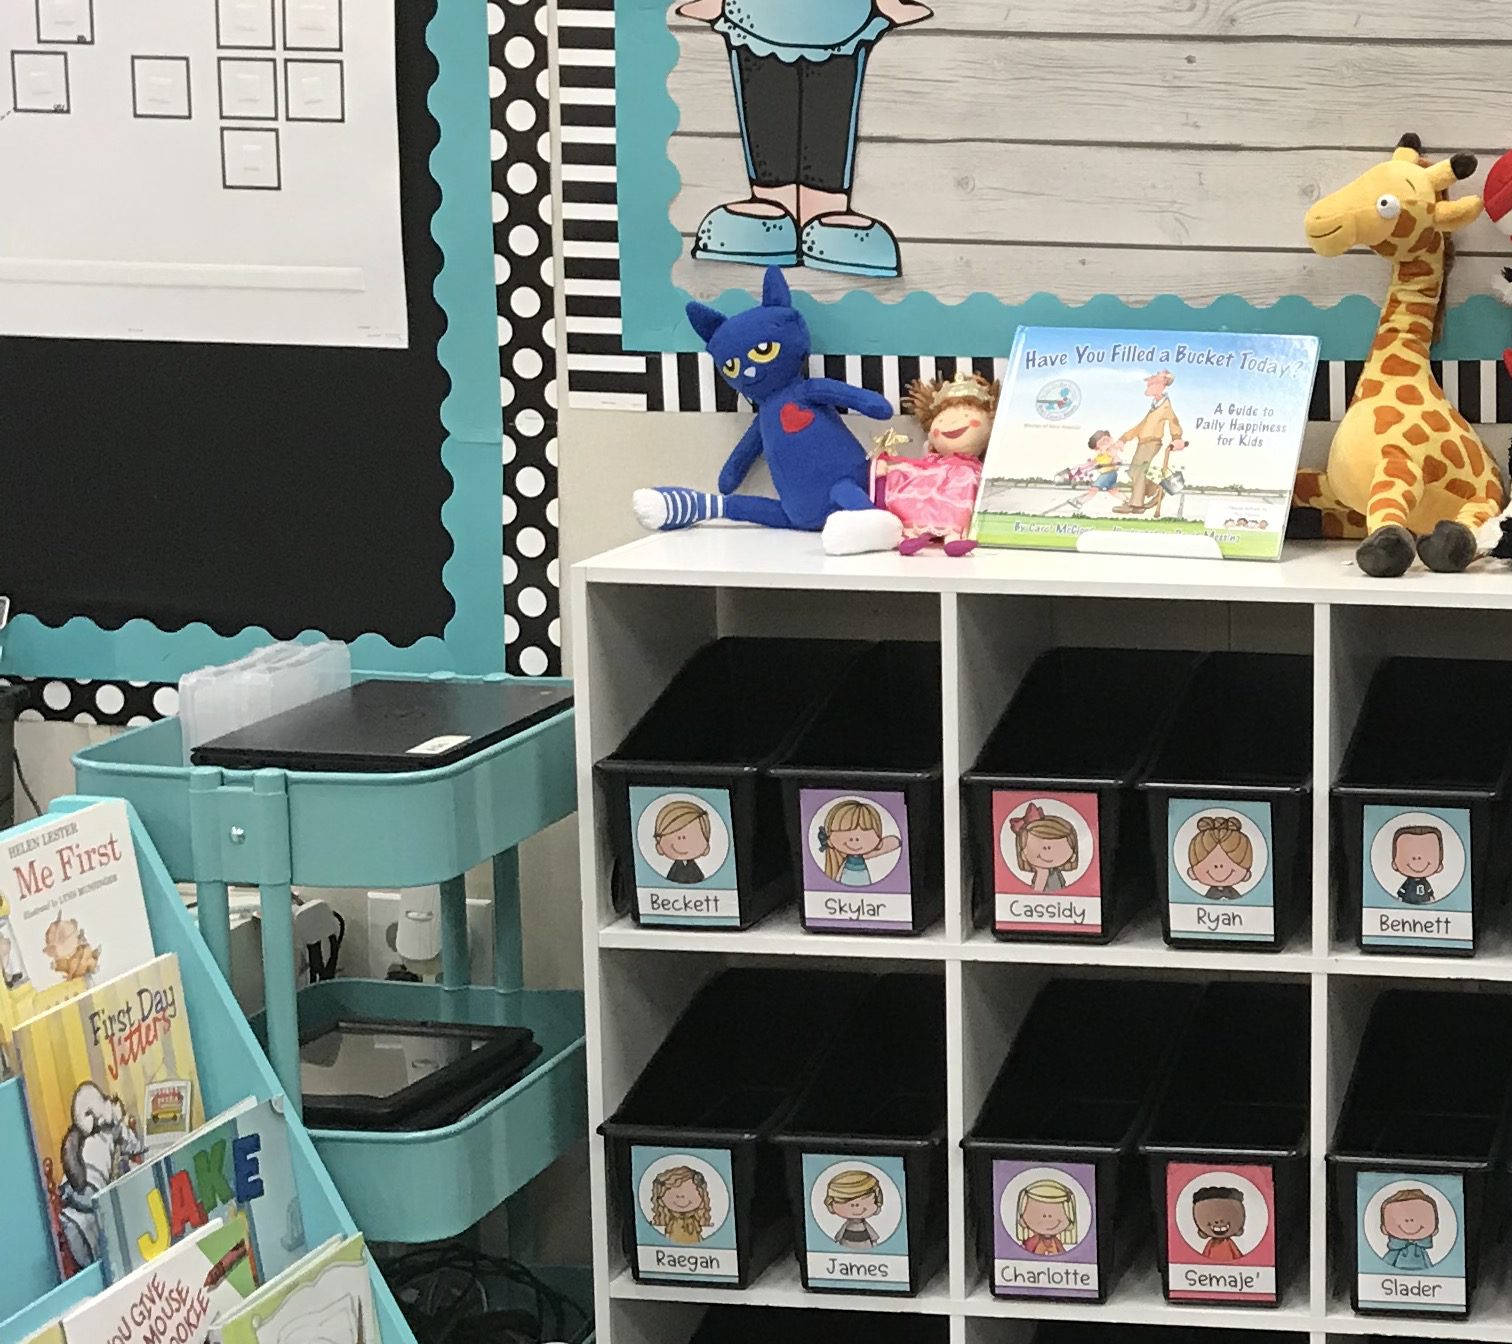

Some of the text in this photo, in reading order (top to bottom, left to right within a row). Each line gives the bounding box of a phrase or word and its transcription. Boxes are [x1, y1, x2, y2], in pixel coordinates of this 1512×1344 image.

[1025, 346, 1303, 378] Have You Filled a Bucket Today?
[1214, 404, 1274, 417] A Guide to
[1196, 417, 1287, 434] Daily Happiness
[1217, 433, 1263, 447] for Kids
[8, 822, 79, 859] HELEN LESTER
[12, 832, 122, 901] Me First
[649, 893, 721, 914] Beckett
[824, 897, 886, 920] Skylar
[1010, 900, 1087, 925] Cassidy
[1197, 908, 1243, 930] Ryan
[1379, 914, 1452, 934] Bennett
[89, 985, 177, 1047] First Day
[107, 1007, 171, 1081] Jitters
[137, 1133, 265, 1262] JAKE
[655, 1250, 720, 1274] Raegan
[827, 1257, 889, 1277] James
[1000, 1266, 1091, 1287] Charlotte
[1186, 1269, 1260, 1291] Semaje'
[130, 1272, 166, 1327] GIVE
[1380, 1279, 1442, 1299] Slader
